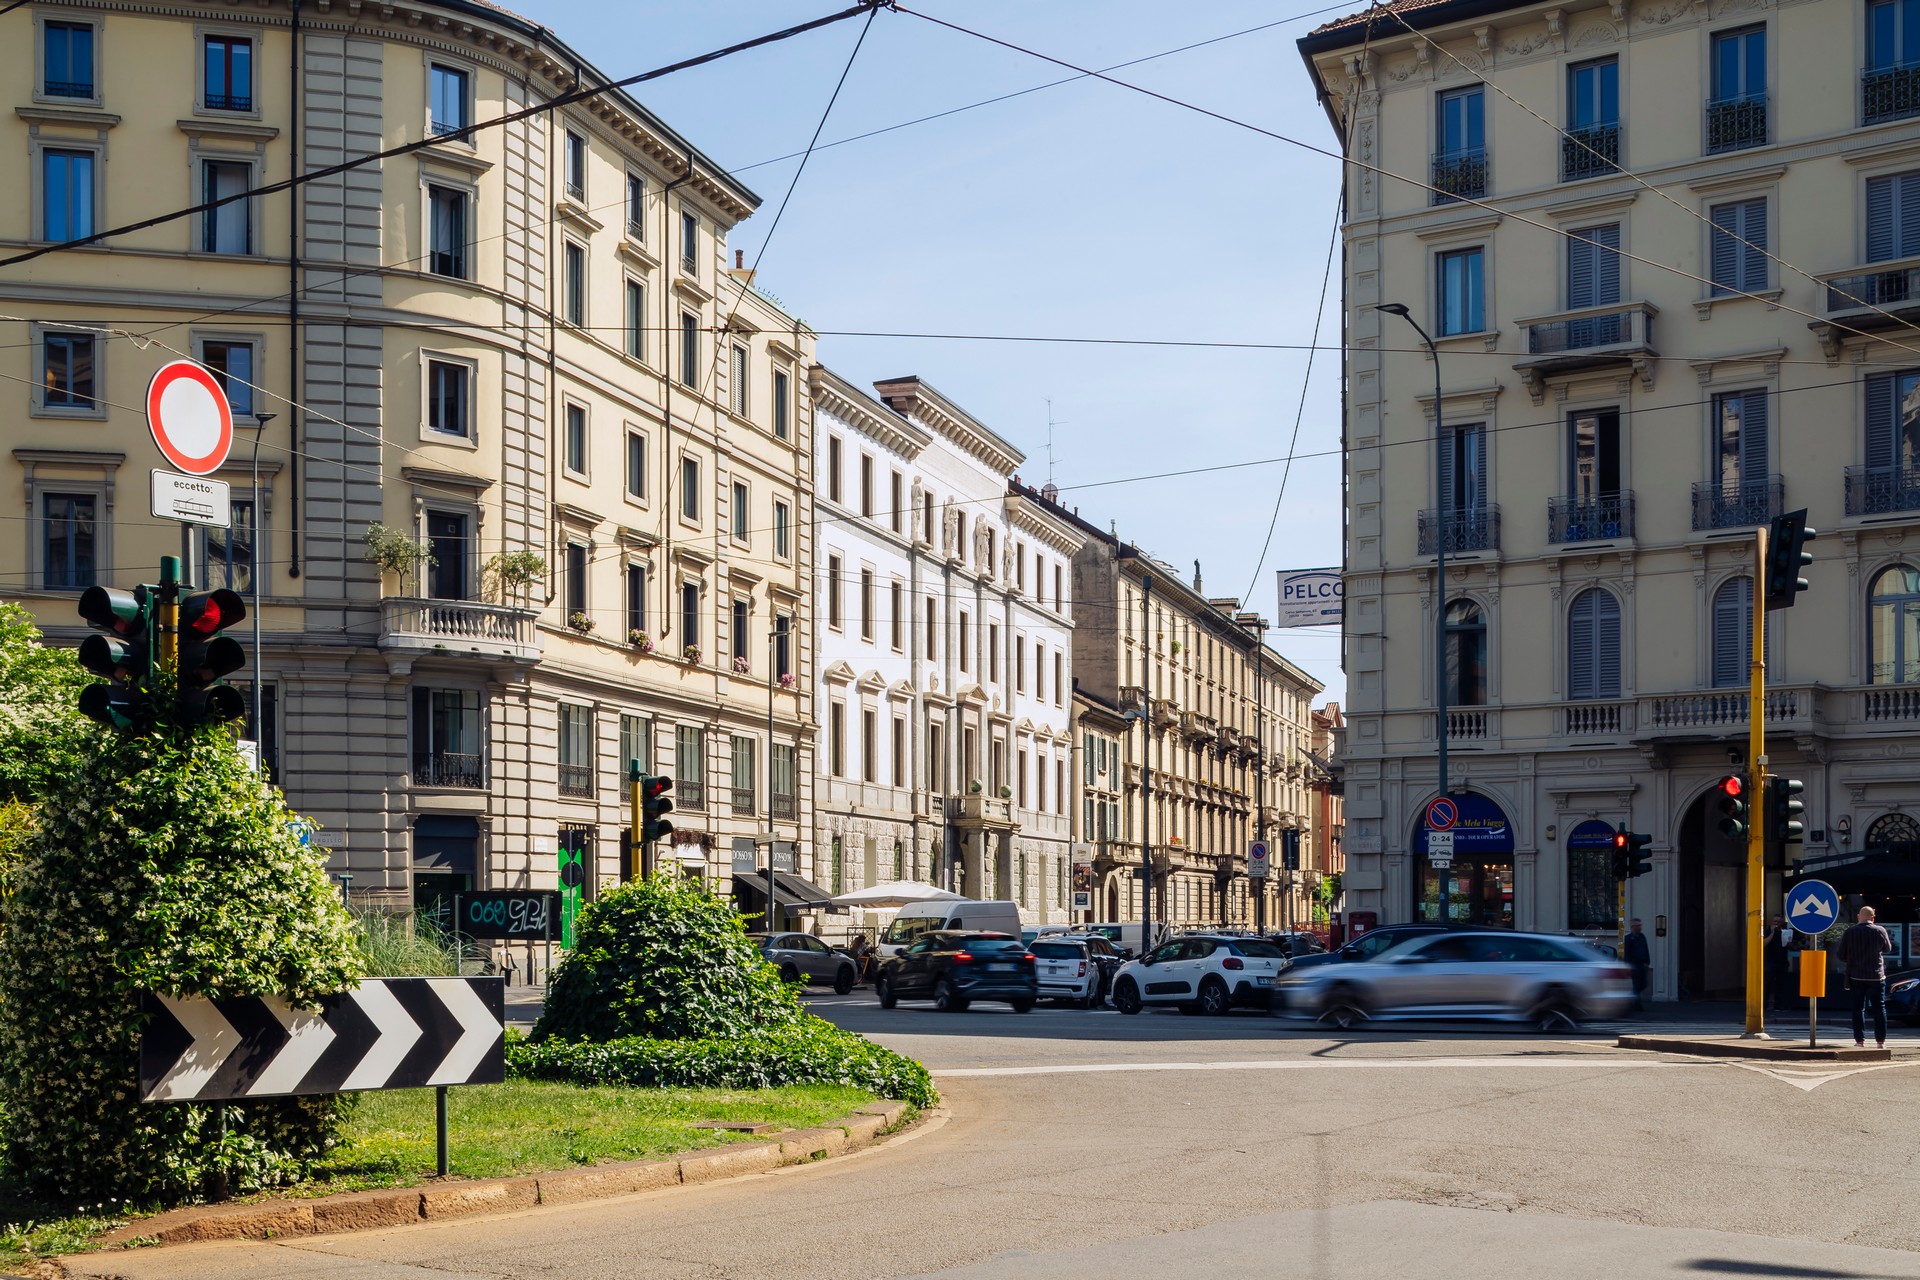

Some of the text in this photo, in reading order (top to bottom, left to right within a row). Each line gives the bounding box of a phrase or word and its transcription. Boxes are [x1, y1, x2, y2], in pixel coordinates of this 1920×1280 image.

[174, 481, 213, 493] eccetto:
[1464, 818, 1481, 828] Mela
[1483, 818, 1505, 828] Viaggi
